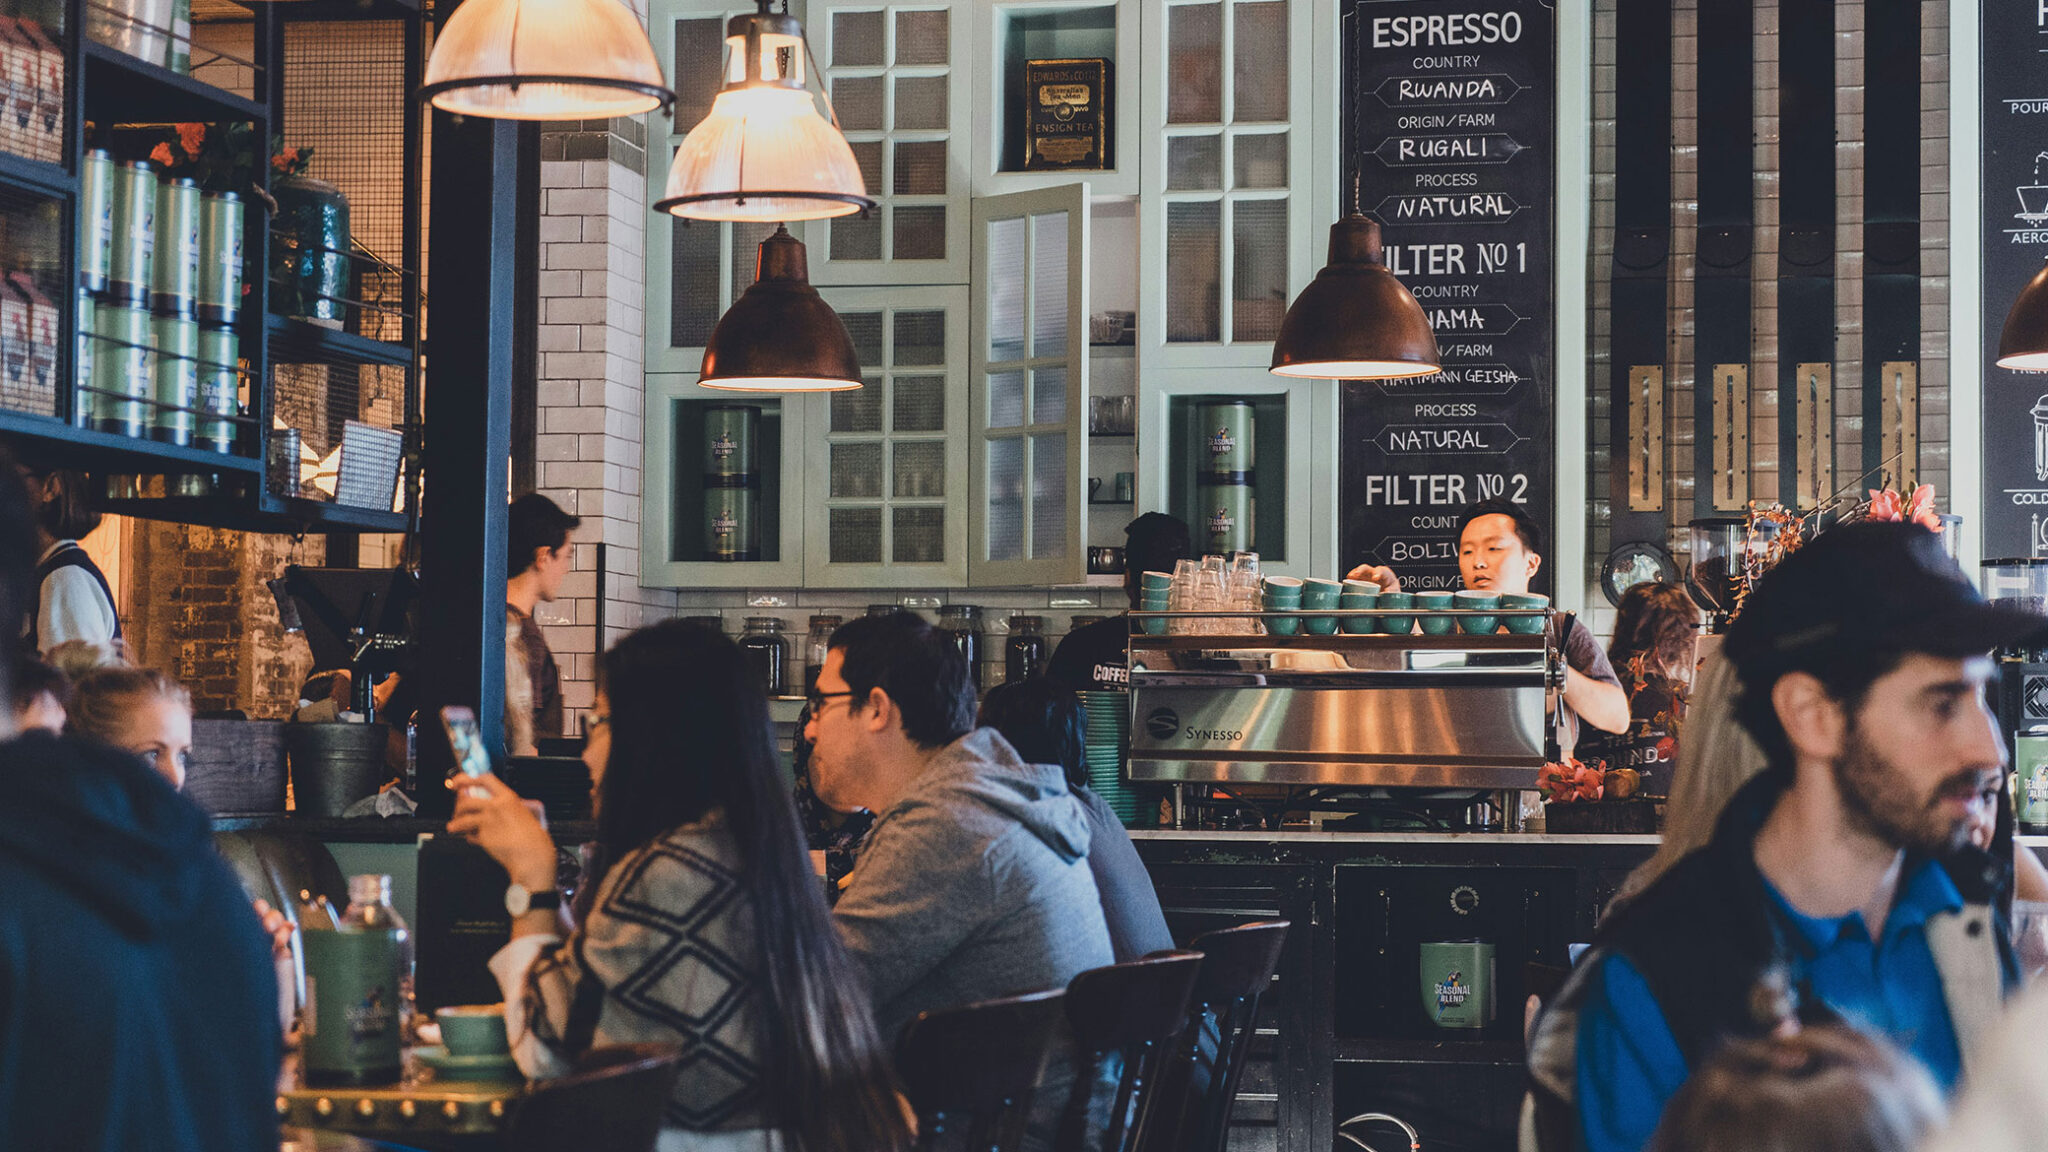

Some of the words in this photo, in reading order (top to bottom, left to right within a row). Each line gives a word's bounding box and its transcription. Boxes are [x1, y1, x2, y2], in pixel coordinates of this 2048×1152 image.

[1373, 12, 1522, 48] ESPRESSO
[1413, 55, 1480, 70] COUNTRY
[1400, 79, 1495, 100] RWANDA
[2011, 102, 2048, 114] POUR
[1035, 123, 1073, 133] ENSIGN
[1076, 122, 1094, 132] TEA
[1398, 113, 1495, 129] ORIGIN/FARM
[1399, 137, 1487, 160] RUGALI
[1415, 173, 1478, 187] PROCESS
[1397, 194, 1512, 218] NATURAL
[1381, 243, 1466, 275] ILTER
[1517, 242, 1526, 273] 1
[1412, 284, 1480, 298] COUNTRY
[1428, 308, 1485, 329] NAMA
[1465, 369, 1518, 384] GEISHA
[1415, 403, 1477, 417] PROCESS
[1390, 430, 1488, 450] NATURAL
[1366, 474, 1467, 505] FILTER
[1511, 473, 1528, 504] 2
[2012, 493, 2048, 505] COLD
[1411, 515, 1460, 529] COUNT
[1398, 575, 1464, 588] ORIGIN/F
[1434, 984, 1470, 995] SEASONAL
[1441, 995, 1464, 1003] BLEND
